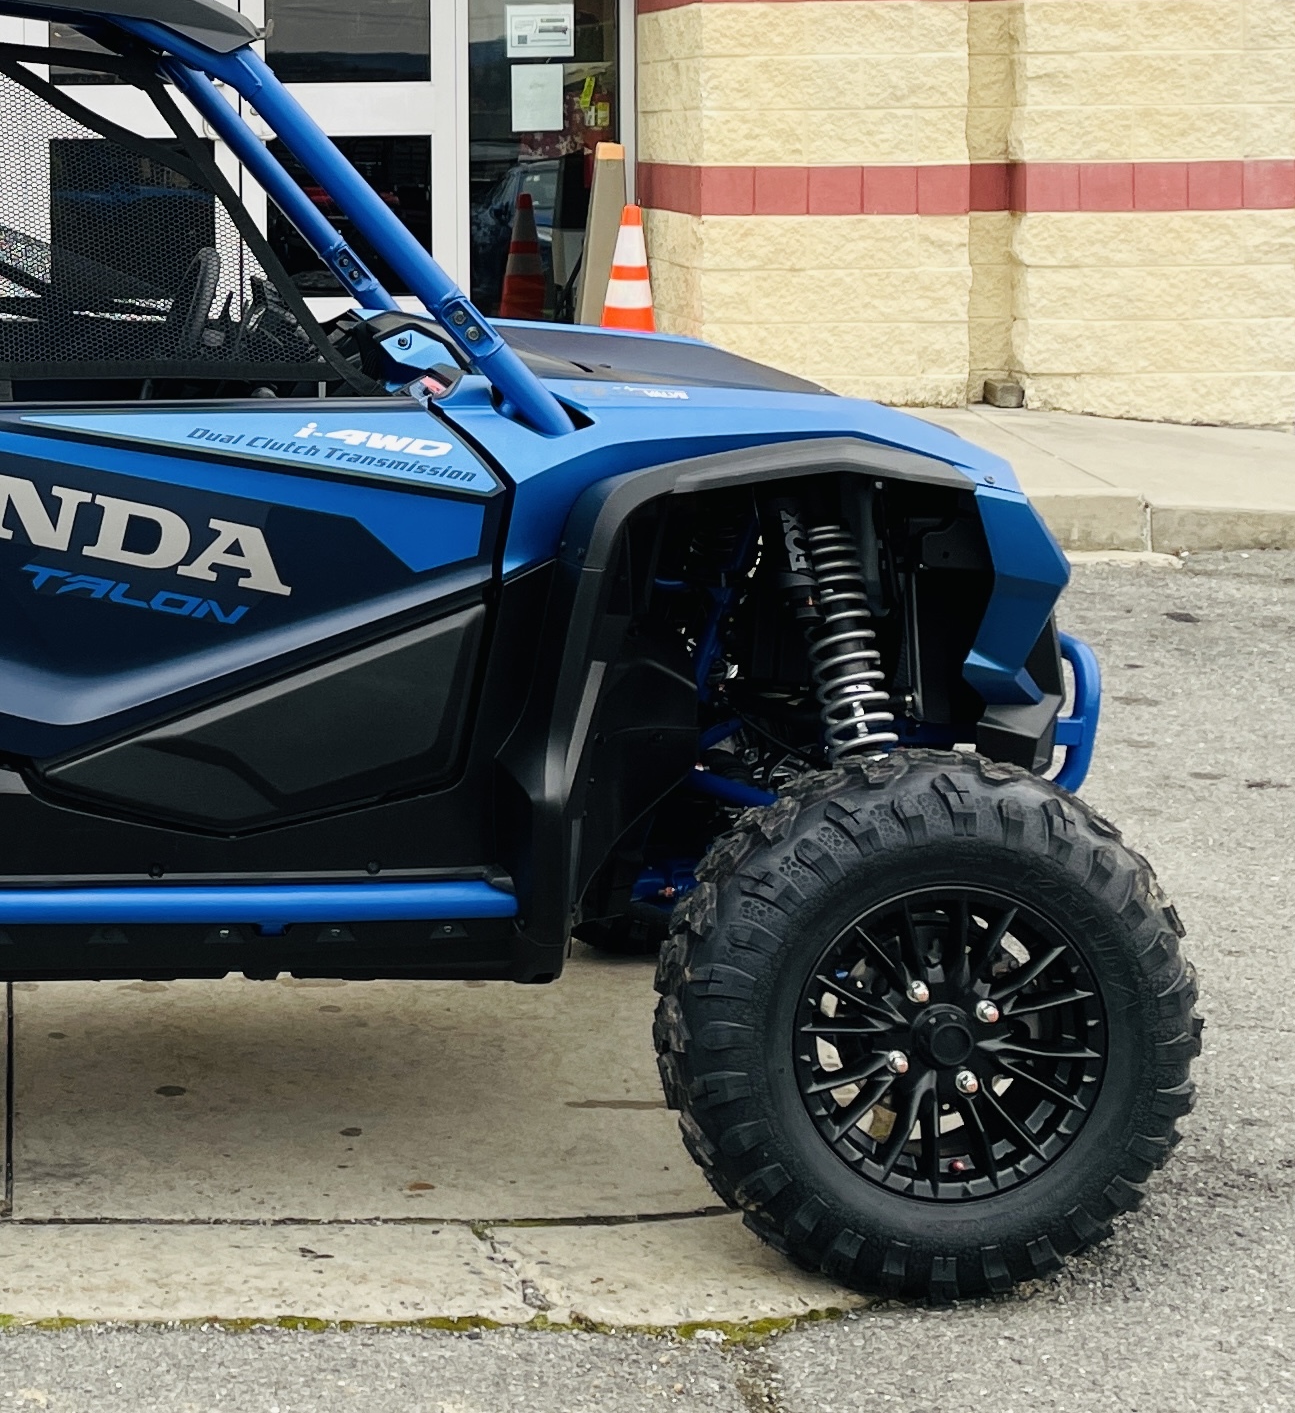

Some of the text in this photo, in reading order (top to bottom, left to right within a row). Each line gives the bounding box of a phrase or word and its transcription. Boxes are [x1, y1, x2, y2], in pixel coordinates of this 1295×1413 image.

[187, 427, 477, 482] Dual Clutch Transmission
[294, 422, 453, 457] i-4WD
[21, 563, 251, 625] TALON
